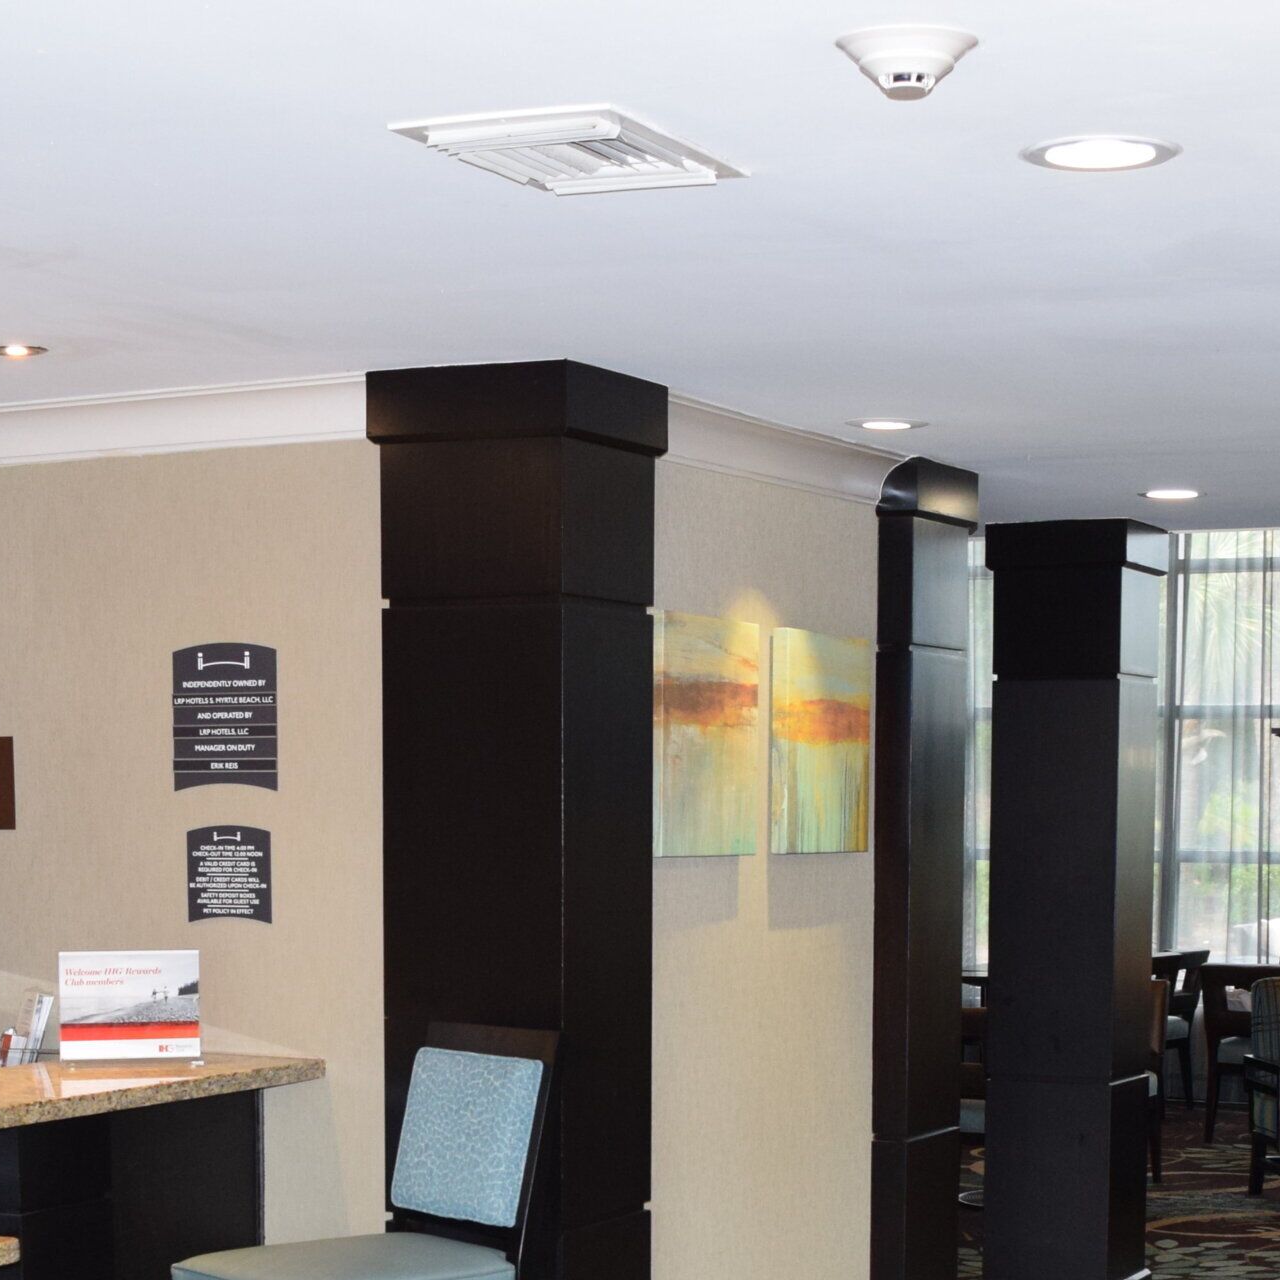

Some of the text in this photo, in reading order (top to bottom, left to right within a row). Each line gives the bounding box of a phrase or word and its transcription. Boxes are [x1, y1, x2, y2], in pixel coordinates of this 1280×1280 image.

[182, 680, 232, 688] INDEPENDENTLY
[65, 968, 102, 976] Welcome
[125, 967, 162, 975] Rewards
